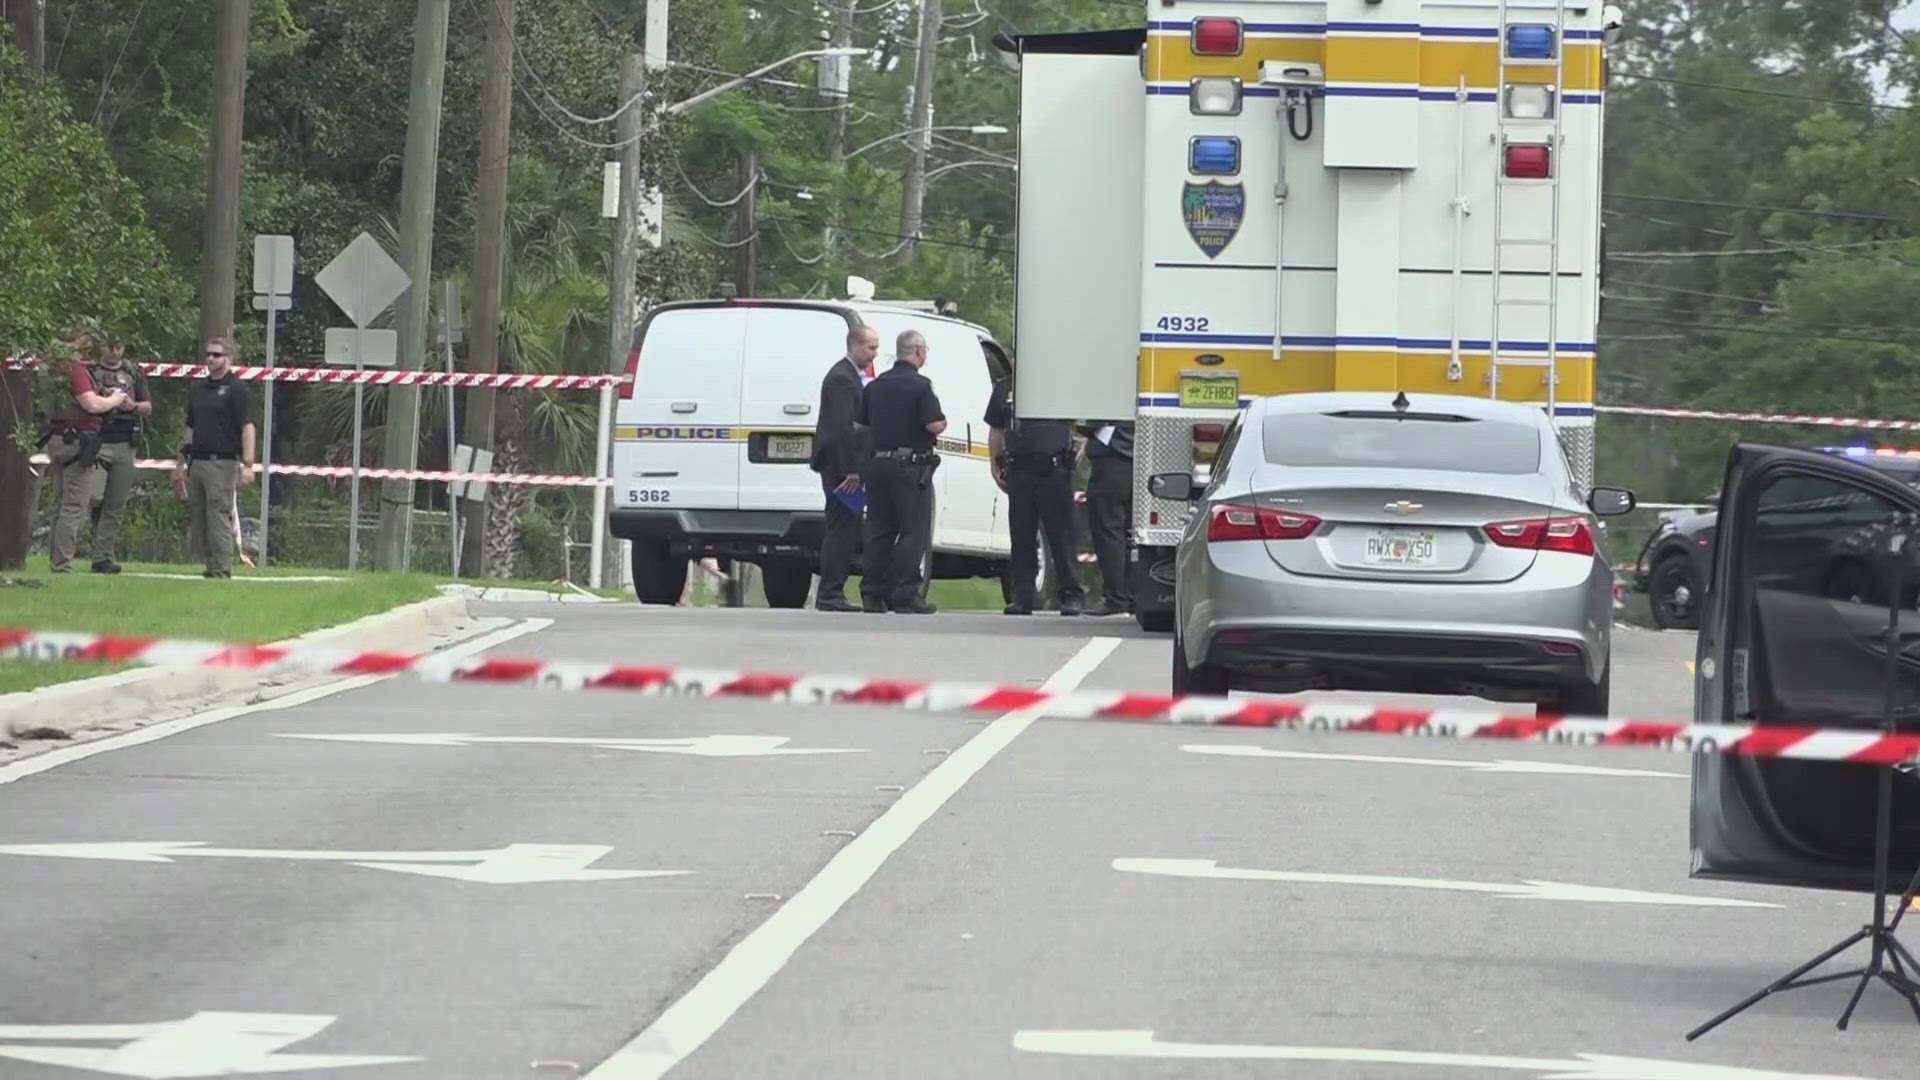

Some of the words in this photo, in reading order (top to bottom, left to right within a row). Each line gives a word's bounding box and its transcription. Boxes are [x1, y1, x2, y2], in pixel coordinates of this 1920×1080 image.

[1157, 316, 1209, 331] 4932
[637, 427, 731, 439] POLICE
[629, 490, 671, 503] 5362
